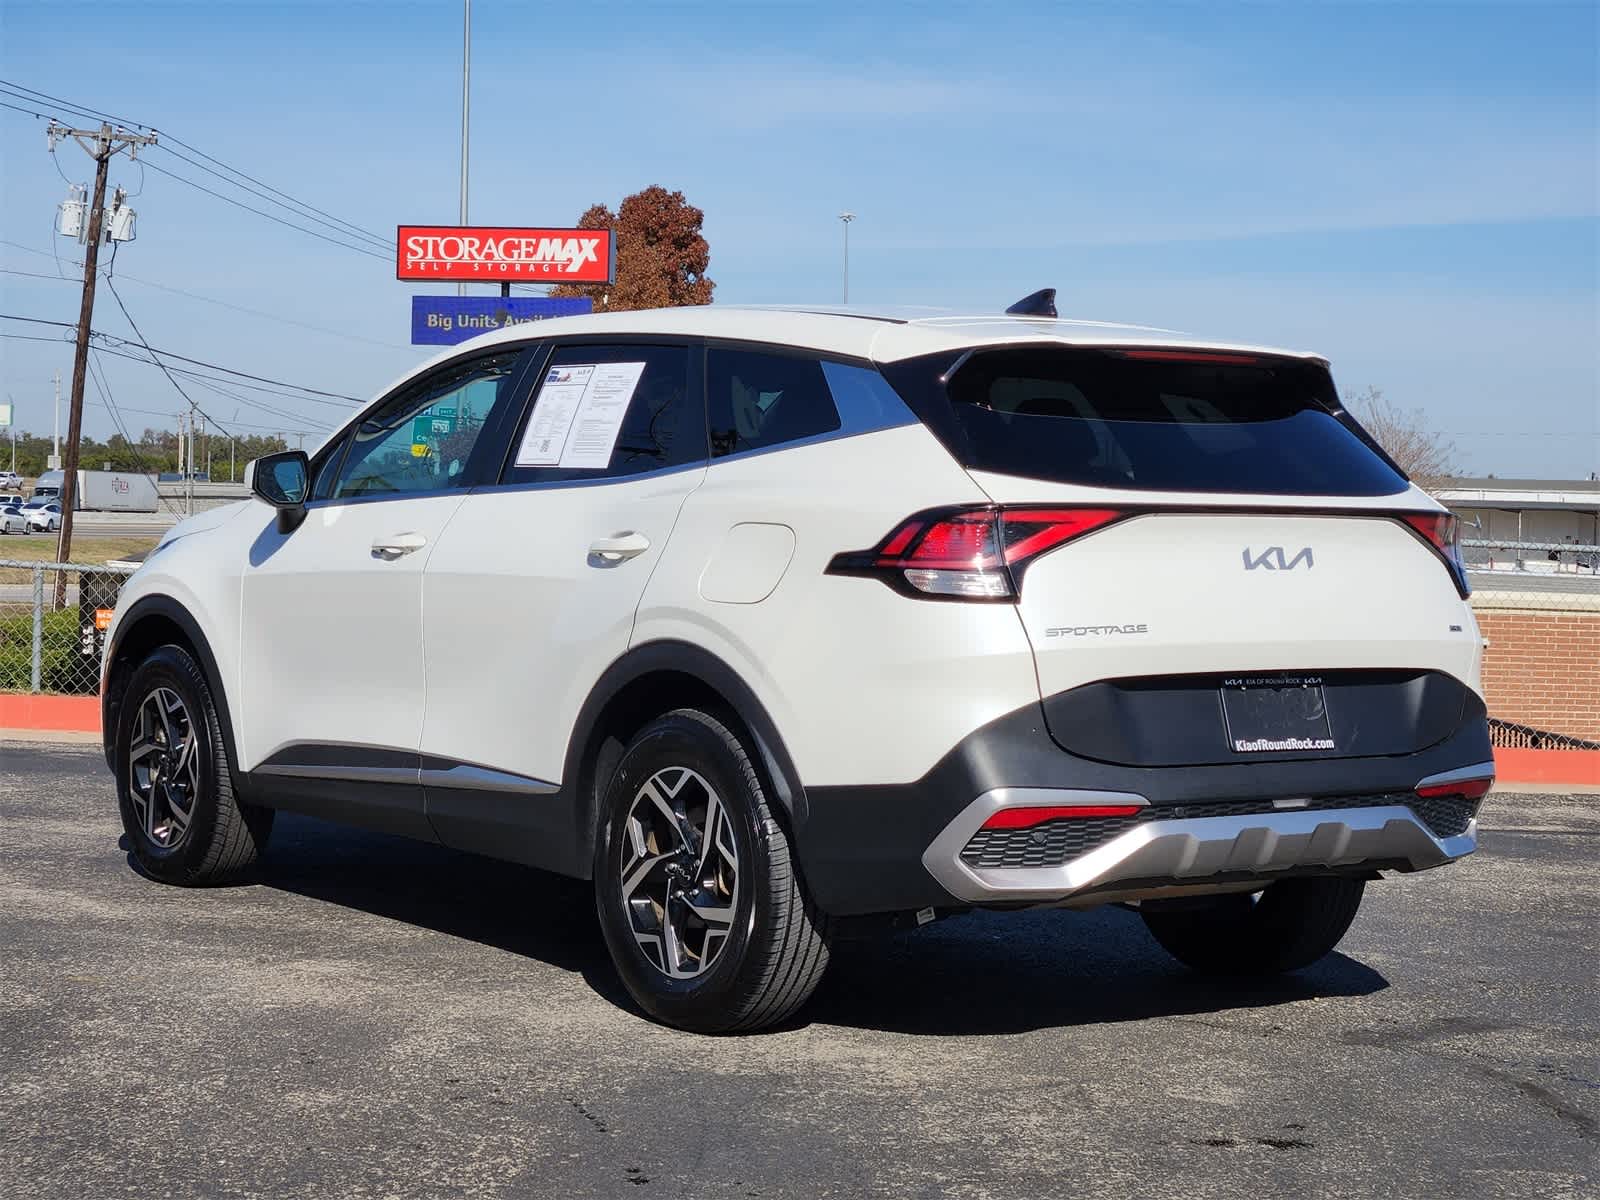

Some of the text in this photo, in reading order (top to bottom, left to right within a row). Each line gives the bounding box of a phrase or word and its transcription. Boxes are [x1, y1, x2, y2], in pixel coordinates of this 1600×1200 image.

[406, 236, 600, 272] STORAGEMAX
[406, 262, 564, 272] SELF STORAGE
[427, 313, 452, 331] Big
[458, 314, 499, 328] Units
[1242, 546, 1314, 570] KIA
[1045, 624, 1149, 637] SPORTAGE
[1235, 738, 1335, 752] KiaofRoundRock.com
